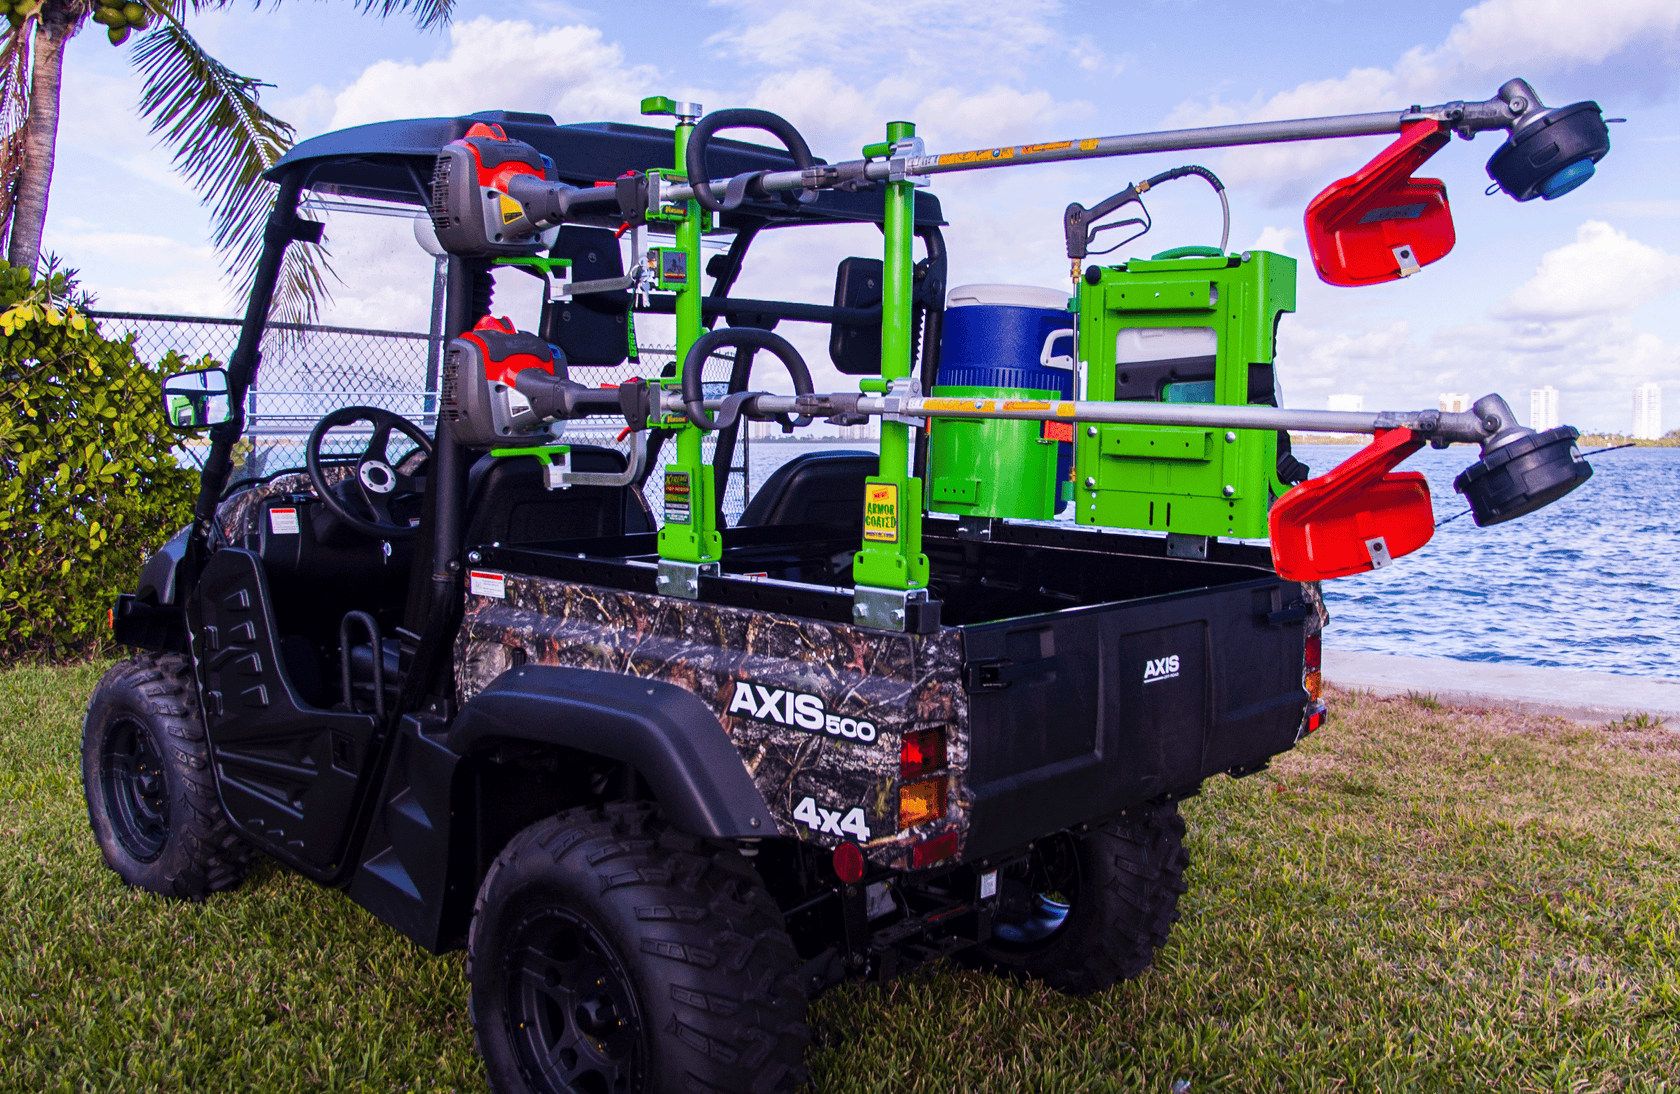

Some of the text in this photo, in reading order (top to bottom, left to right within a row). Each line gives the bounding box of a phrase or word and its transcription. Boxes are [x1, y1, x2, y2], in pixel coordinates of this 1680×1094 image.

[867, 503, 894, 515] ARMOR
[865, 515, 896, 528] COATED
[1144, 654, 1180, 679] AXIS
[793, 796, 871, 842] 4x4
